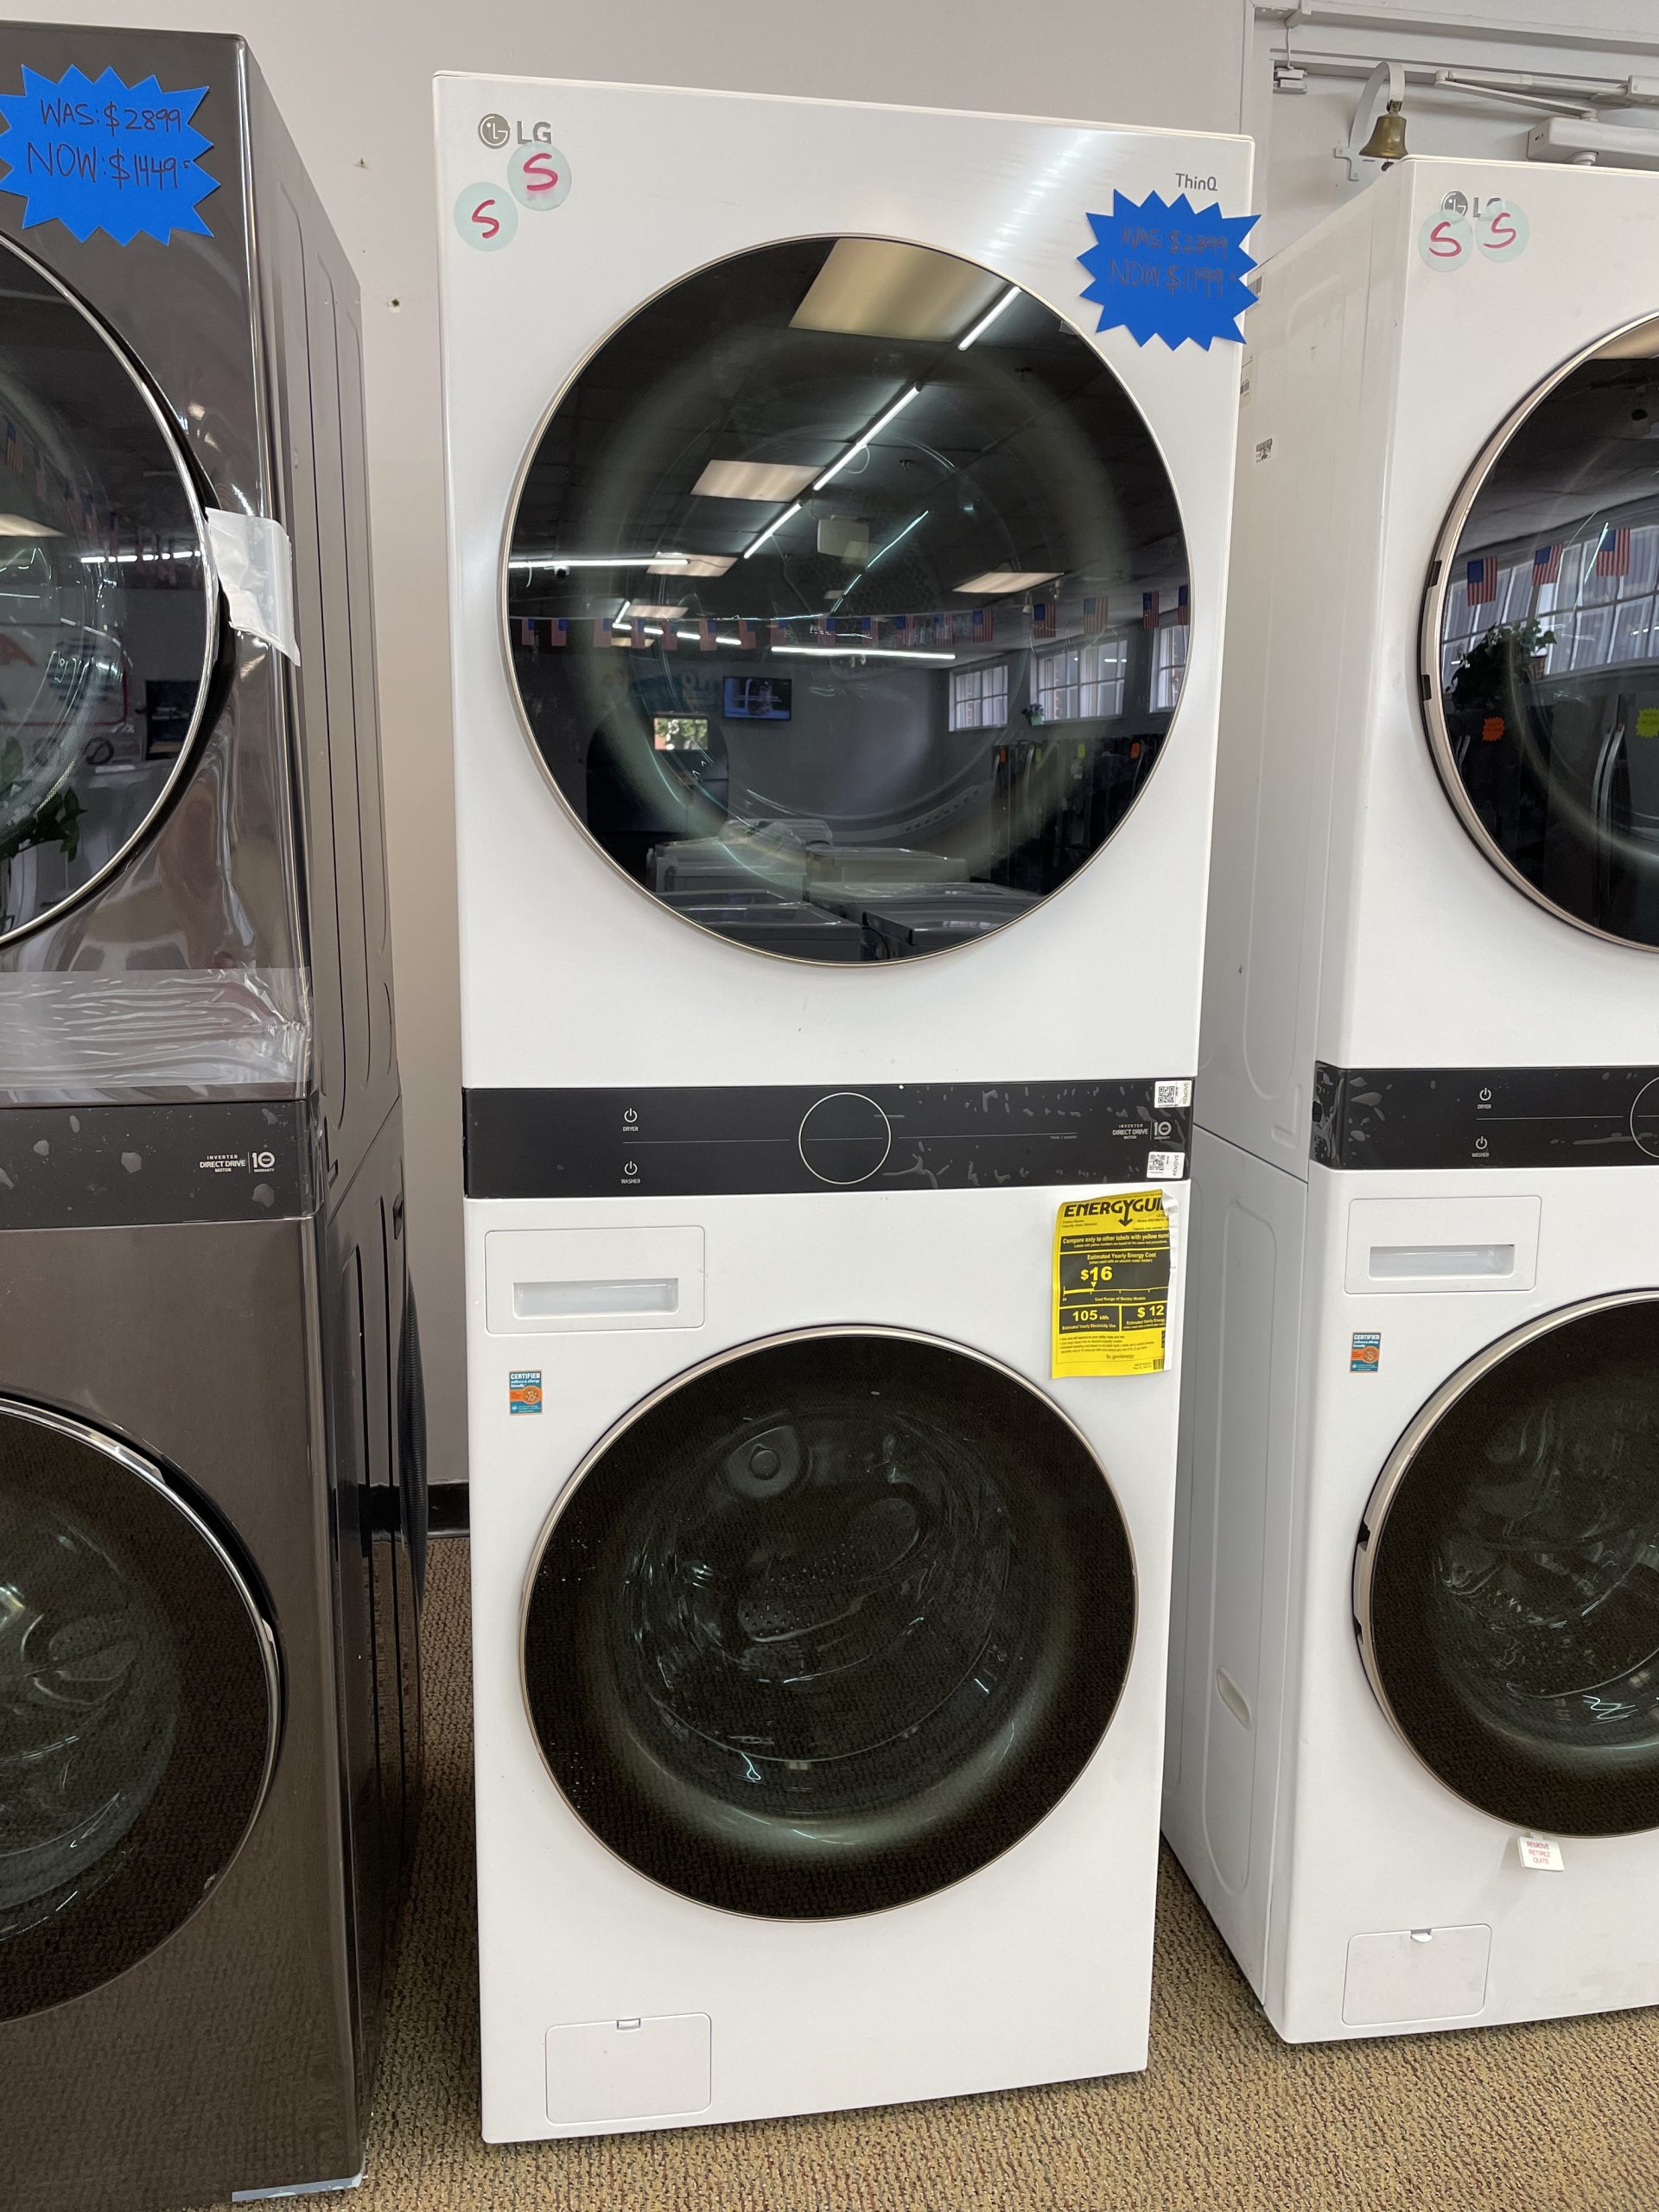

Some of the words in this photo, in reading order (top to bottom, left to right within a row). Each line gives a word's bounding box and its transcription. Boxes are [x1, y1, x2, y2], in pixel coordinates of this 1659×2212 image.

[517, 120, 552, 144] LG
[523, 153, 558, 191] S
[1175, 172, 1217, 191] ThinQ
[1472, 196, 1502, 219] L
[1429, 221, 1462, 257] S
[1080, 1265, 1113, 1281] $16
[1072, 1309, 1098, 1322] 105
